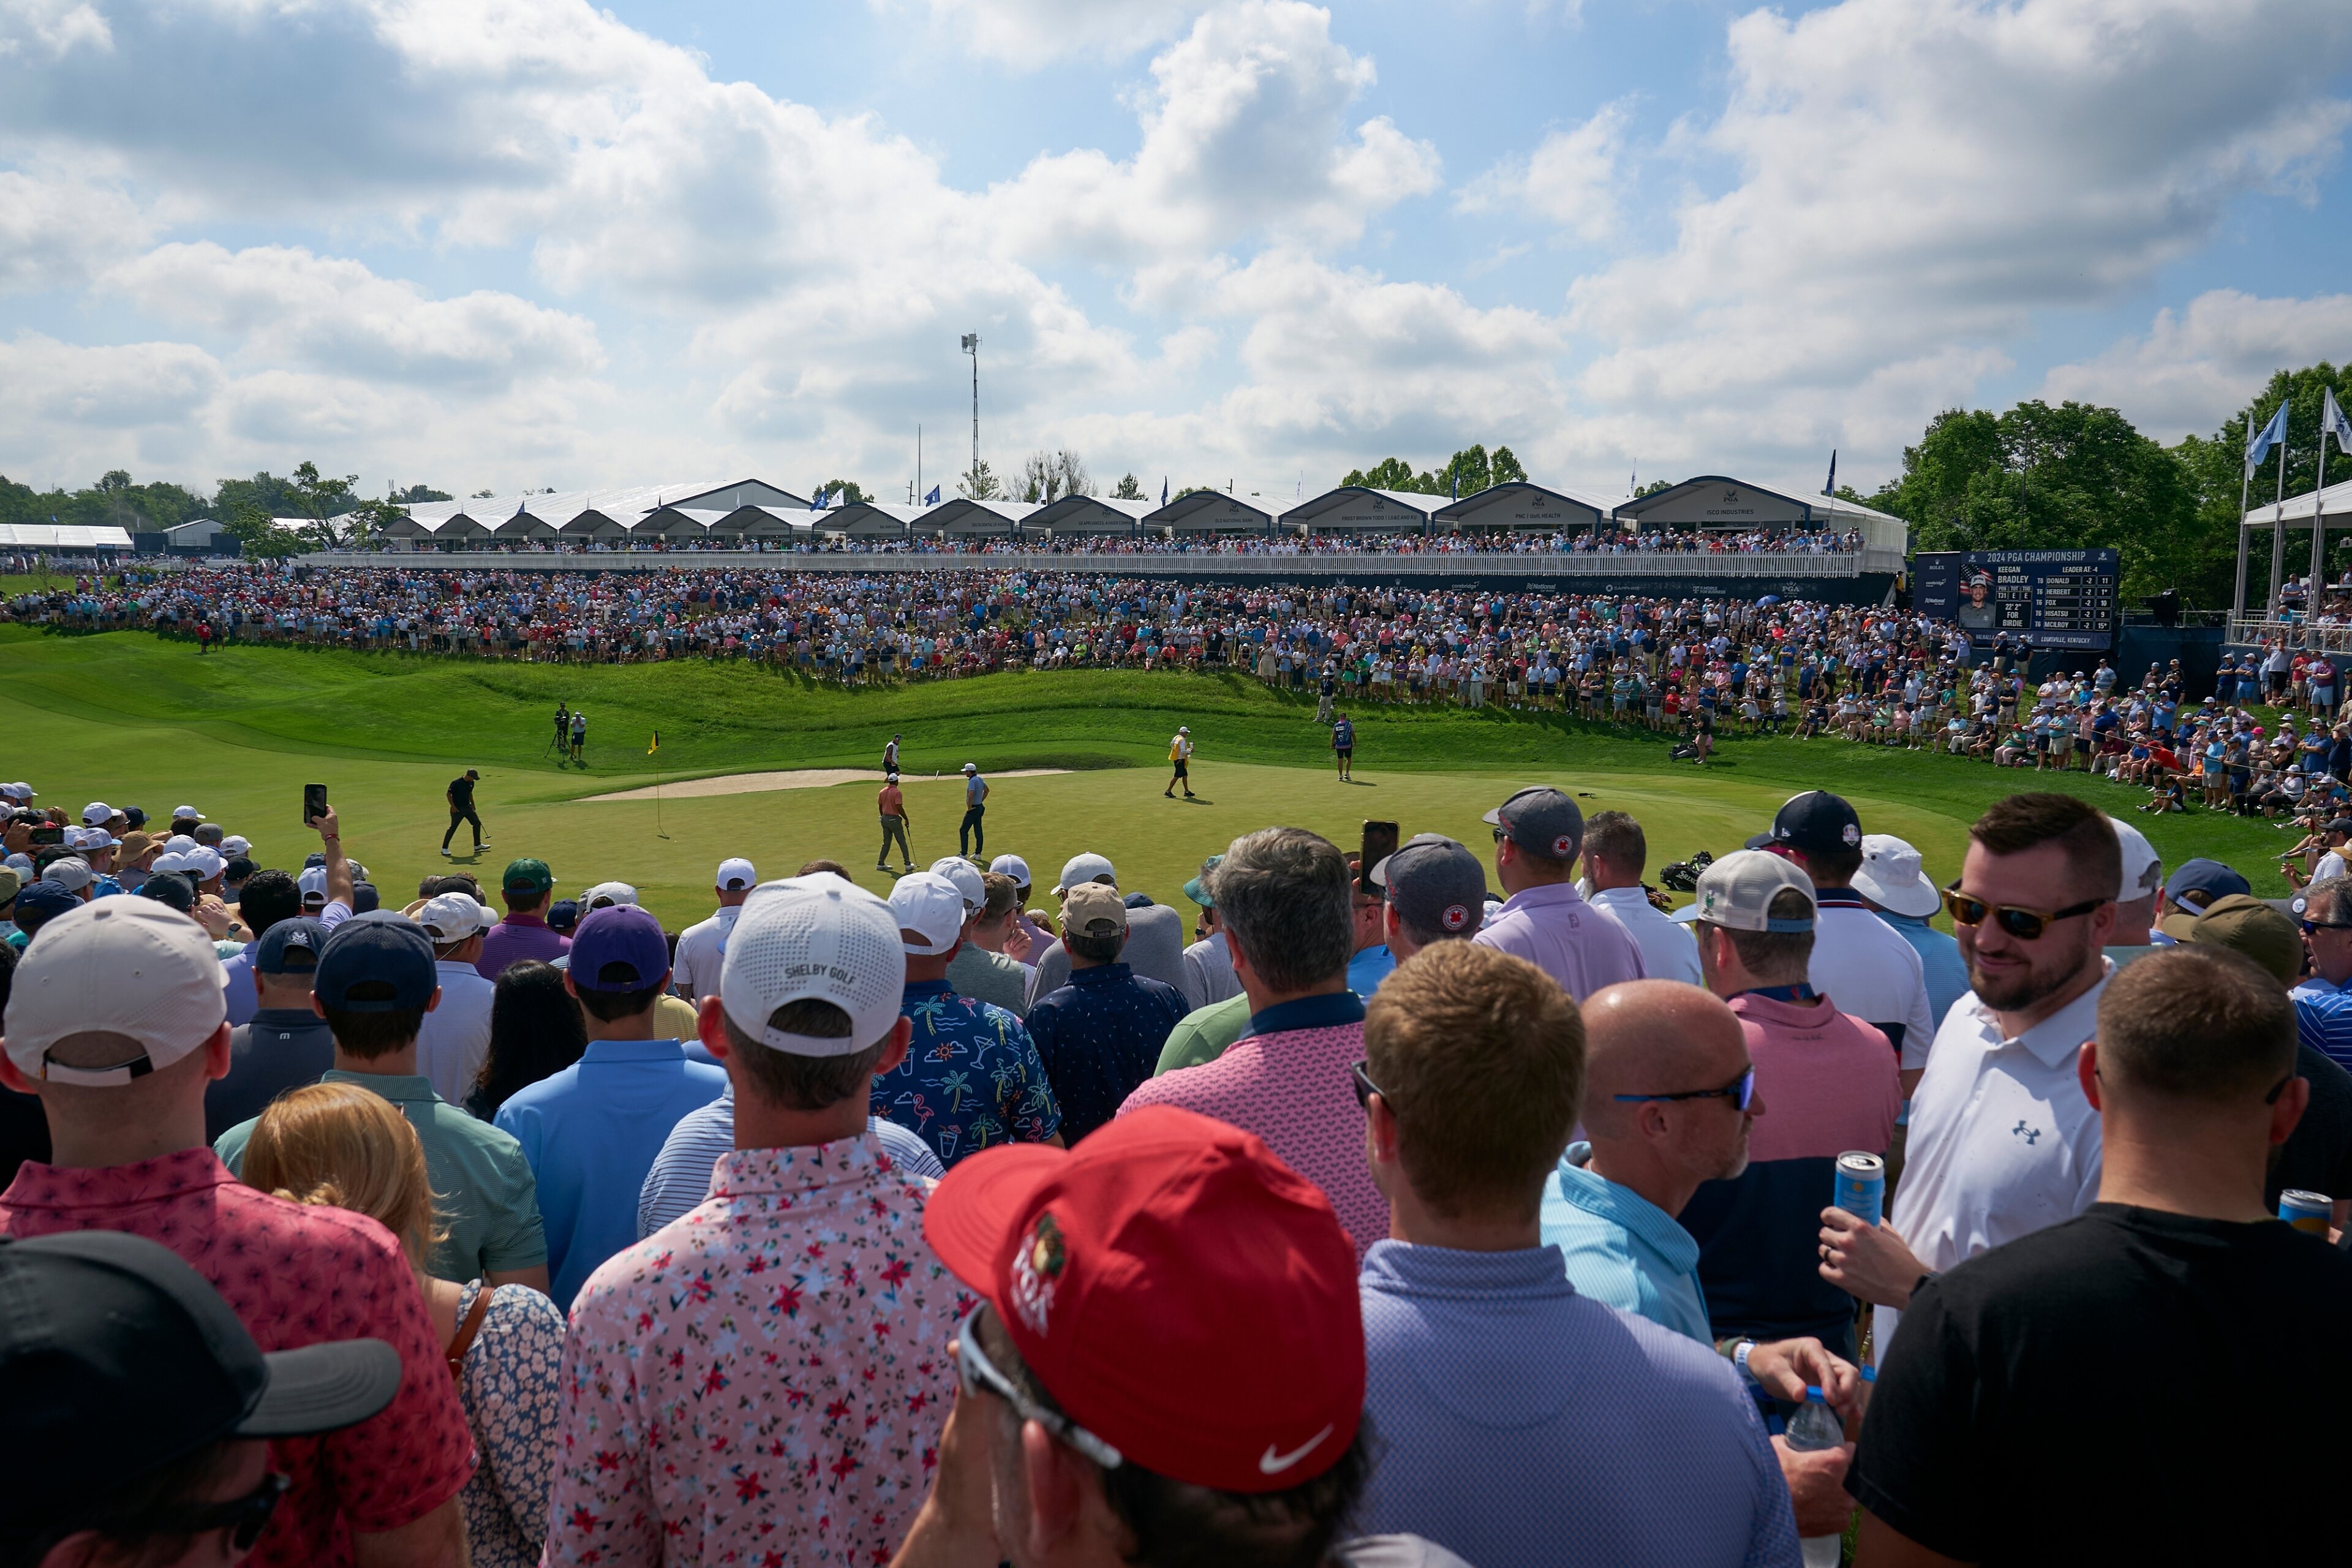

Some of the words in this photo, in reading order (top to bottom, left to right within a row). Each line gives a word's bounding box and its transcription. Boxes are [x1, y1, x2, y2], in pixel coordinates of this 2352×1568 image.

[1987, 552, 2005, 562] 2024
[2008, 552, 2022, 562] PGA
[2025, 551, 2086, 562] CHAMPIONSHIP
[1678, 870, 1697, 885] SRIXO
[785, 963, 827, 979] SHELBY
[829, 967, 856, 986] GOLF
